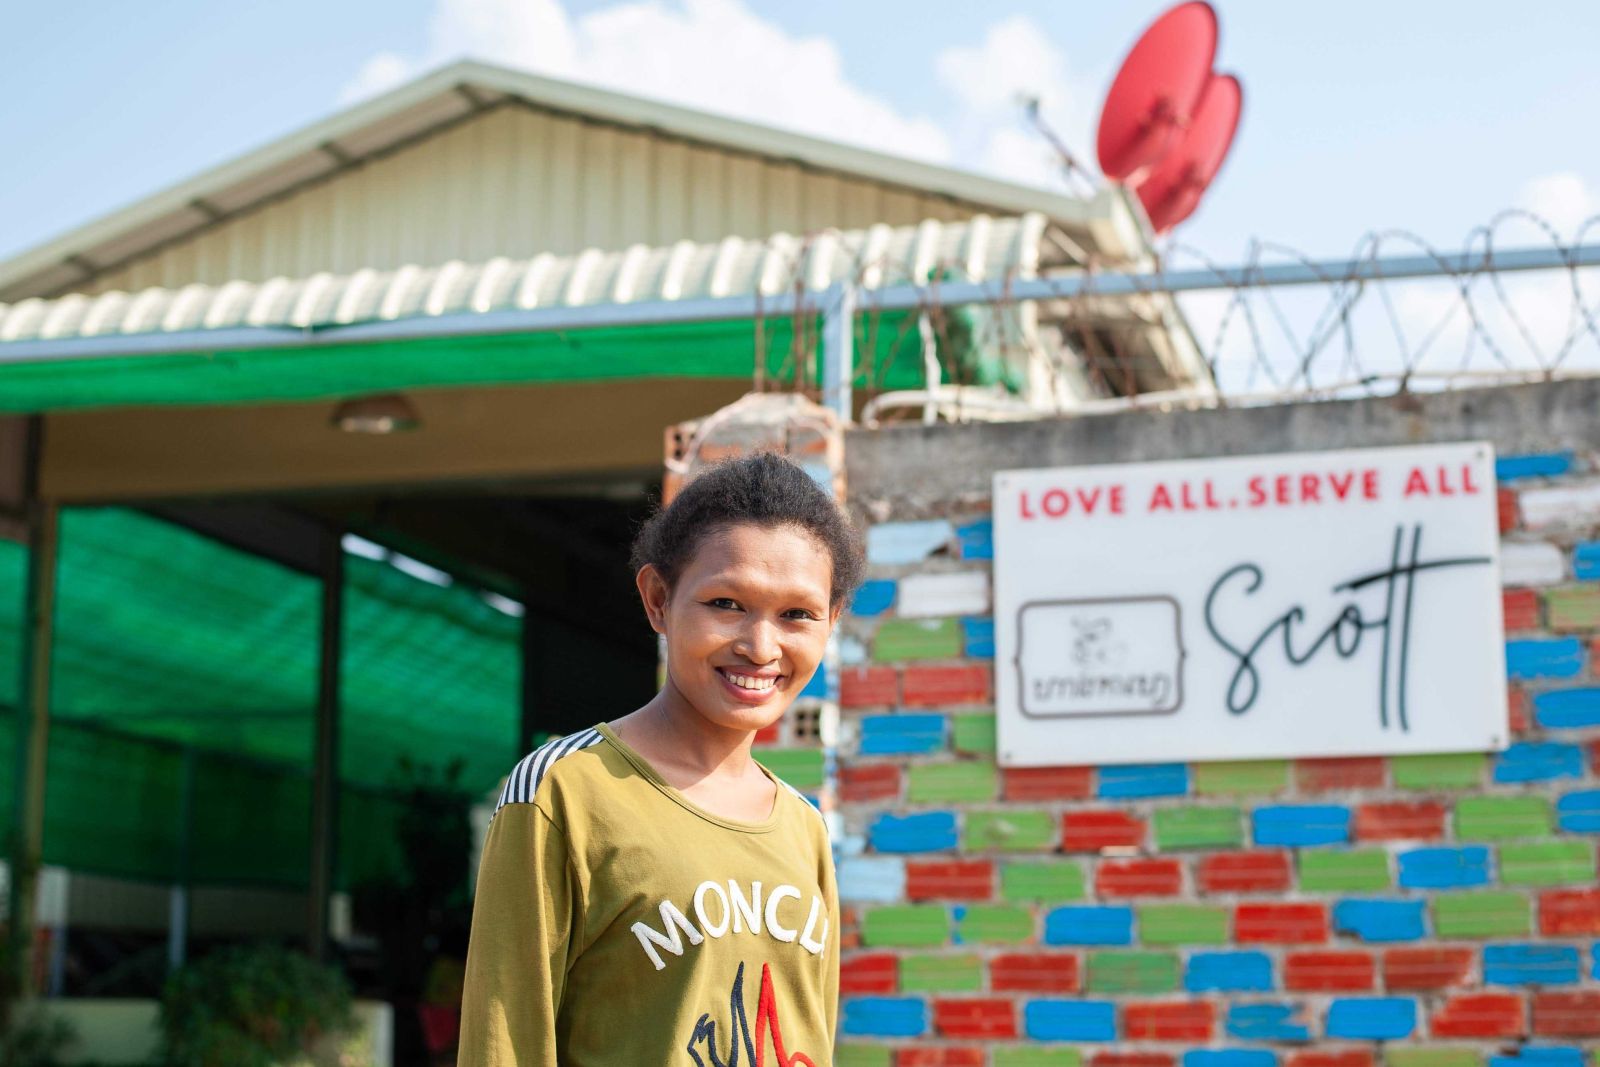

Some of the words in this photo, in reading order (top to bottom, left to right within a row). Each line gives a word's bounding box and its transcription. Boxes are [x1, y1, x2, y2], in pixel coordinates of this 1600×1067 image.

[1019, 485, 1124, 520] LOVE
[1403, 465, 1479, 497] ALL
[1203, 523, 1491, 732] Scott
[631, 879, 829, 970] MONCL
